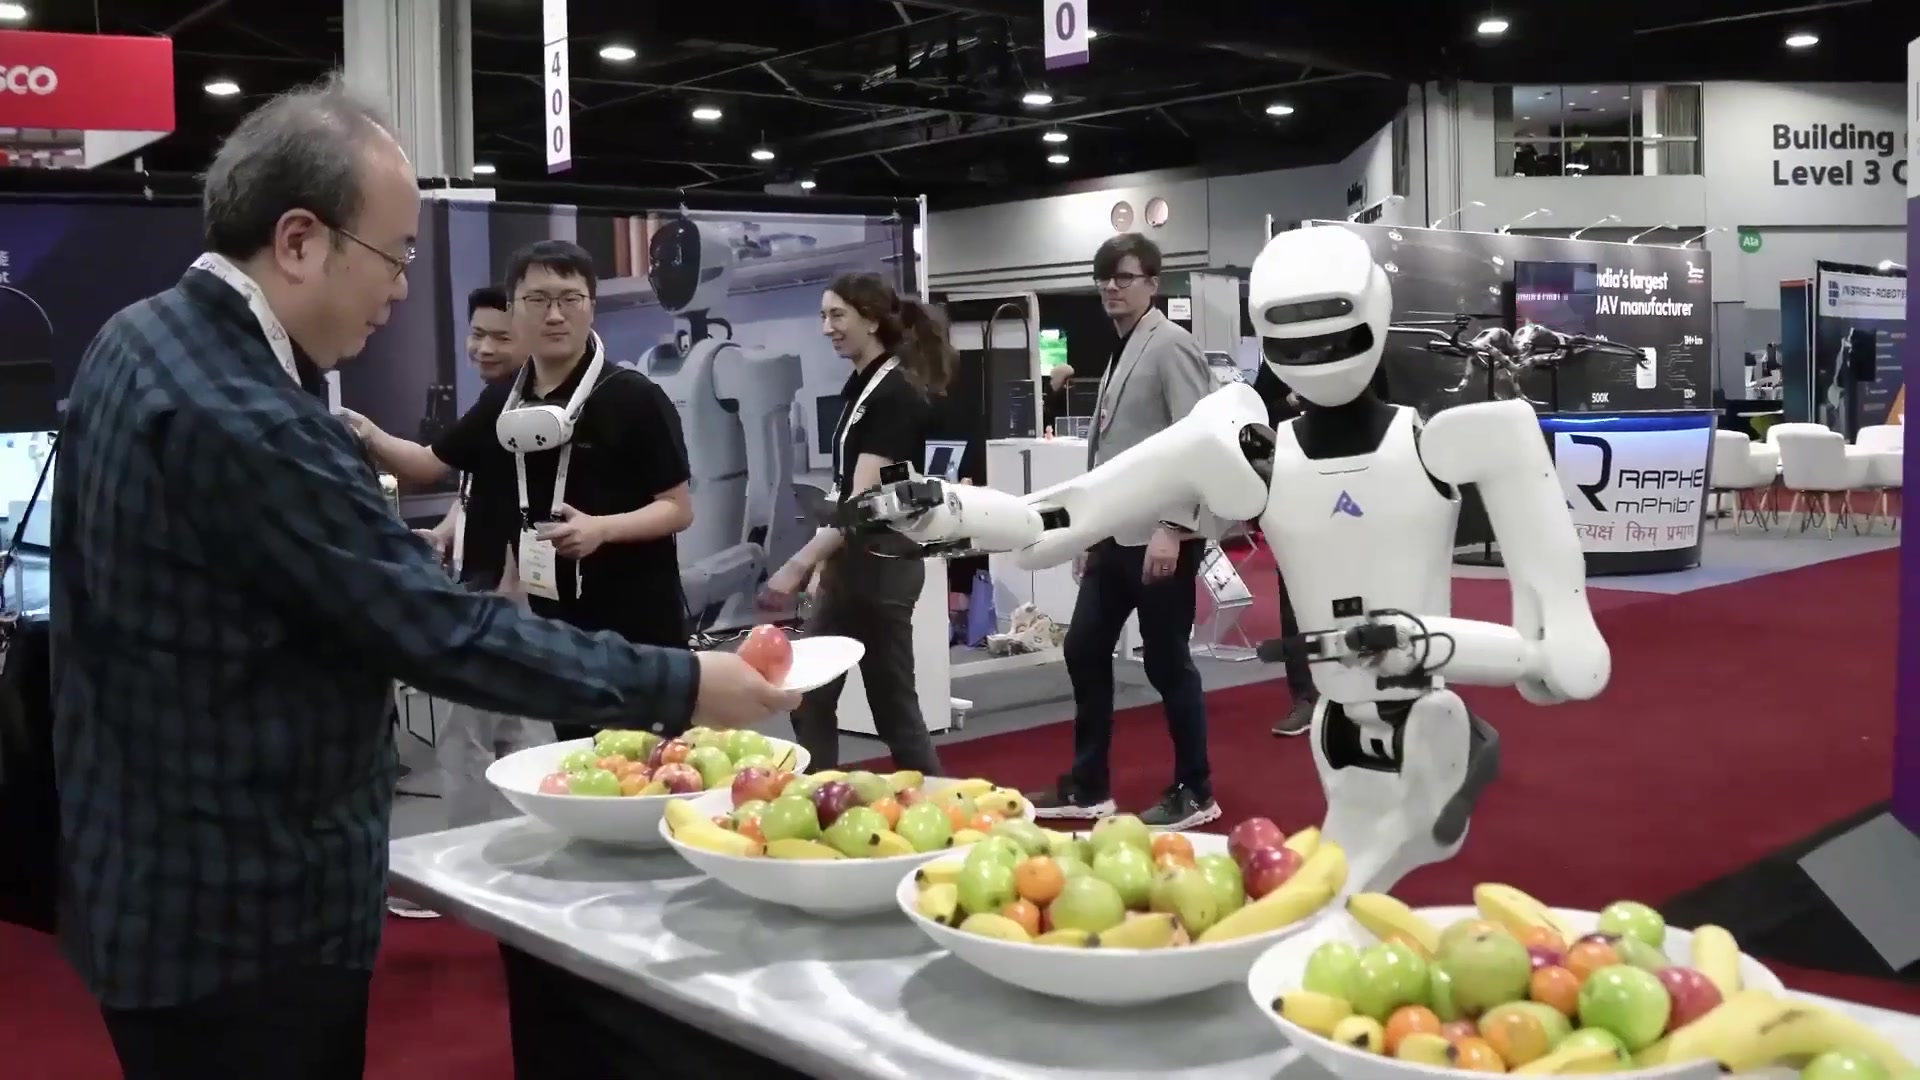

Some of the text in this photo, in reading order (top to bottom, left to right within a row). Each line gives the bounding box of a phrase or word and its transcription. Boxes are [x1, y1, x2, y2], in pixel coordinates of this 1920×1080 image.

[1055, 2, 1075, 40] 0
[0, 65, 58, 95] CO
[1773, 123, 1894, 157] Building
[1773, 160, 1853, 186] Level
[1863, 160, 1880, 186] 3
[1596, 268, 1668, 294] ndia's largest
[1620, 297, 1693, 317] manufacturer
[1592, 392, 1609, 403] 500K
[1618, 468, 1704, 489] RAPHE
[1615, 497, 1695, 513] mPhibr
